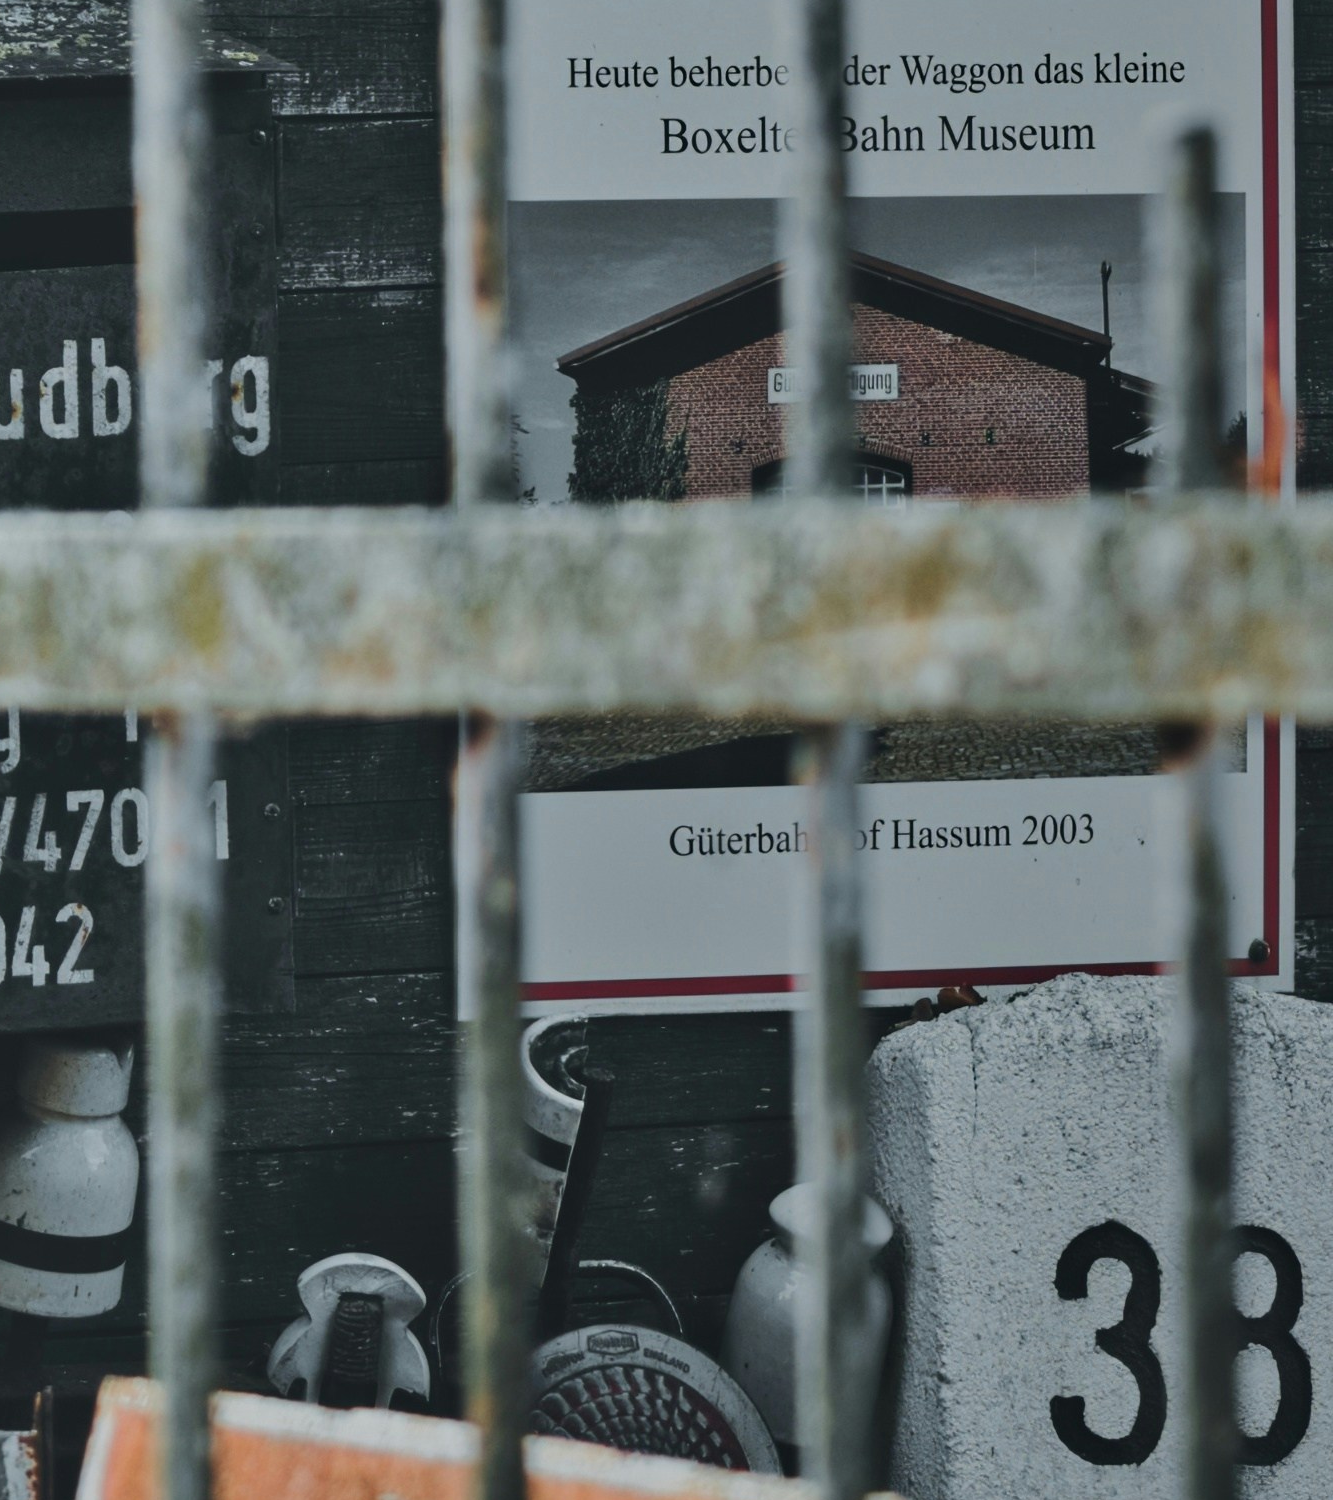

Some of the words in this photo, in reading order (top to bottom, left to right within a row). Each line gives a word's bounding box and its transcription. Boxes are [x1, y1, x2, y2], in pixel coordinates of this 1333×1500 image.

[567, 55, 659, 89] Heute
[668, 52, 792, 88] beherbe
[841, 52, 892, 85] der
[899, 53, 1024, 92] Waggon
[1033, 52, 1084, 86] das
[1092, 51, 1186, 86] kleine
[660, 114, 797, 155] Boxelte
[937, 113, 1096, 153] Museum
[890, 818, 1012, 851] Hassum
[1021, 813, 1095, 846] 2003
